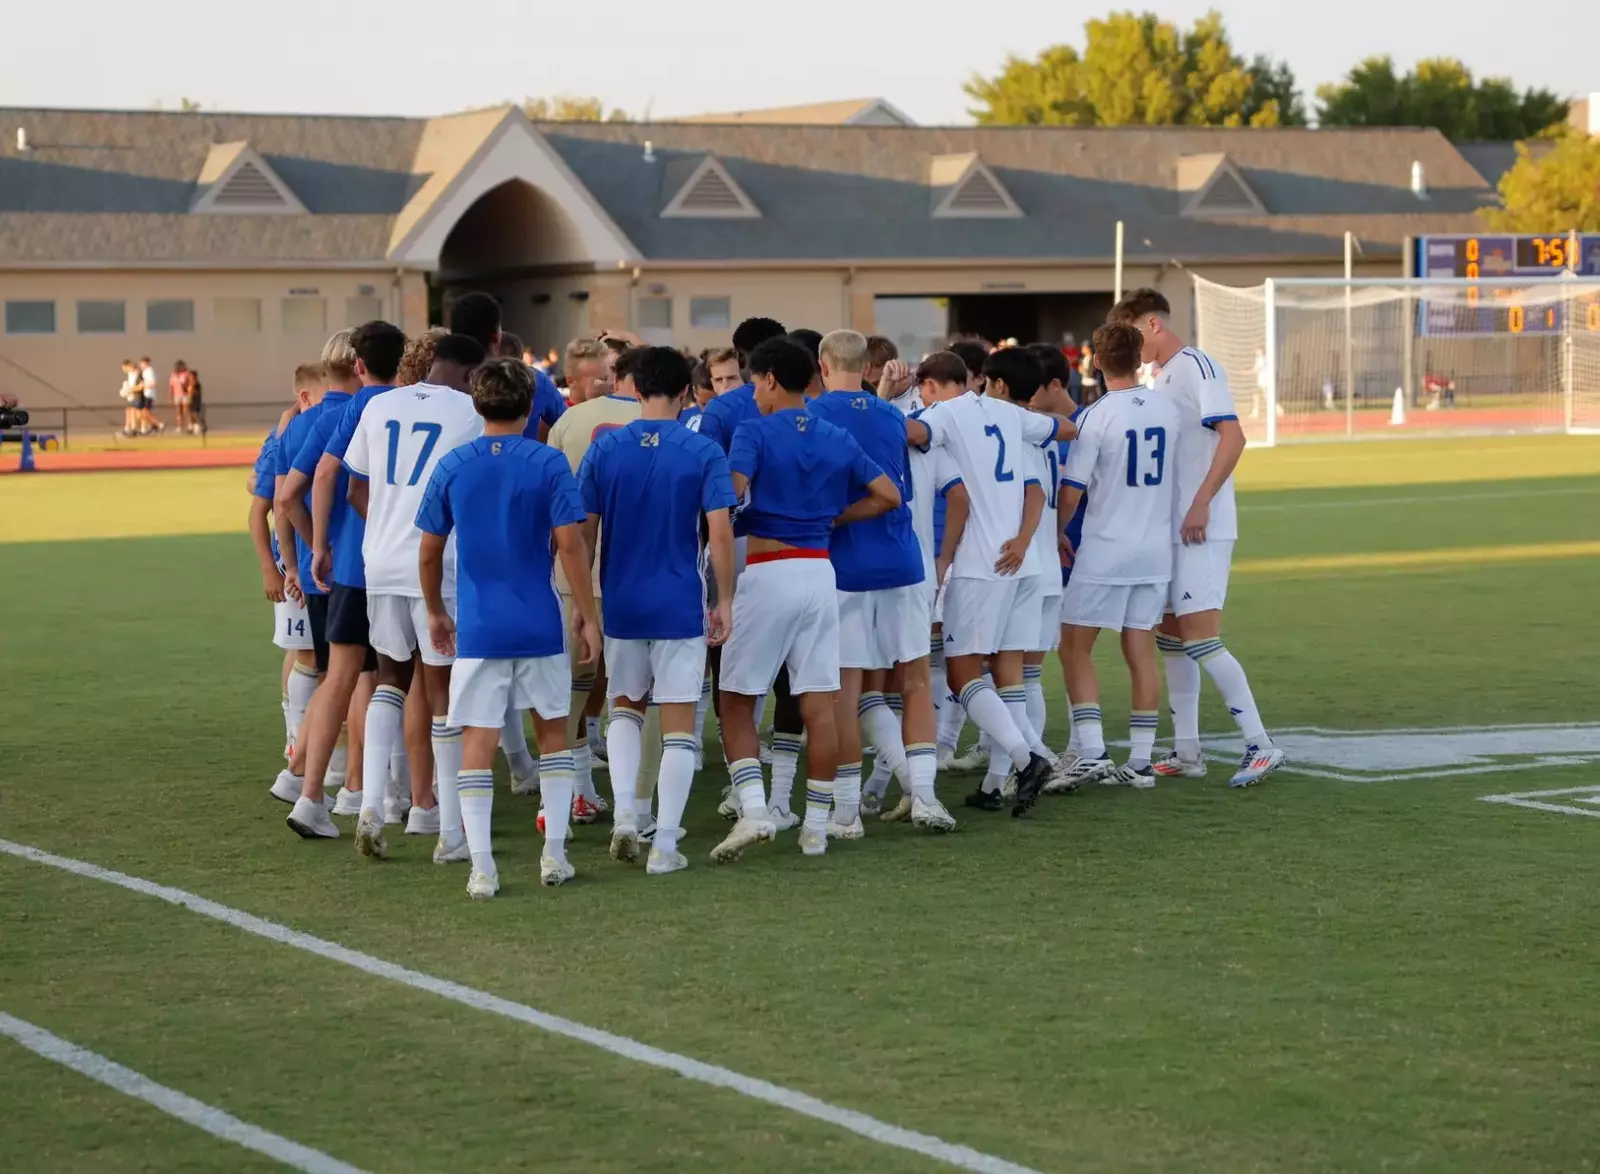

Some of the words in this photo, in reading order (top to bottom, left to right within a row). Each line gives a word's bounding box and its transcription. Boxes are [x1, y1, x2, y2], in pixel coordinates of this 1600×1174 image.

[1509, 304, 1524, 333] 0
[385, 419, 443, 486] 17
[491, 441, 502, 456] 6
[641, 432, 660, 448] 24
[984, 424, 1014, 482] 2
[1126, 426, 1166, 487] 13
[287, 617, 306, 637] 14
